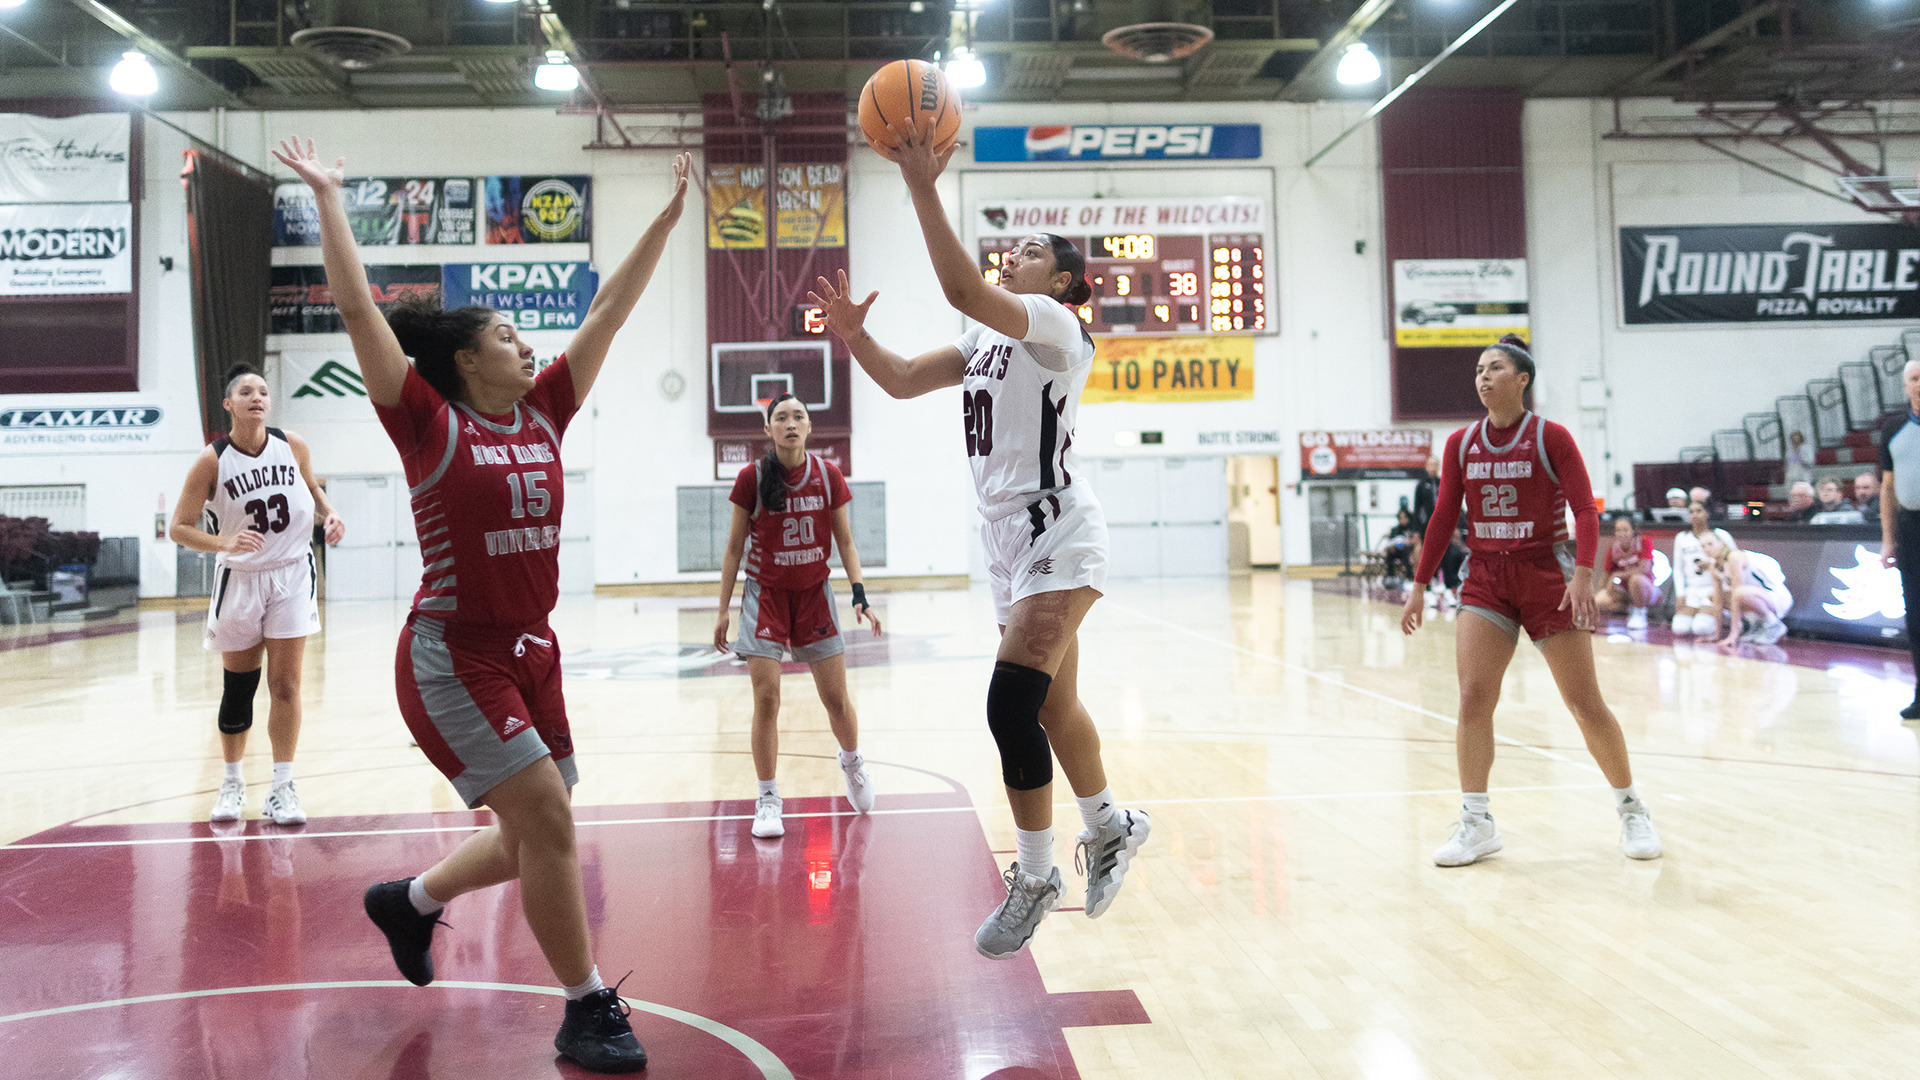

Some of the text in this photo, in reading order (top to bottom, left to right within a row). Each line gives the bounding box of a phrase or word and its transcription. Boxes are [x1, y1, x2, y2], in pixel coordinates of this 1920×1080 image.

[1068, 126, 1213, 156] PEPSI
[357, 180, 388, 206] 12
[405, 180, 435, 205] 24
[776, 190, 822, 210] ARDEN
[1013, 203, 1260, 227] HOME OF THE WILDCATS!
[0, 228, 123, 259] MODERN
[1103, 234, 1156, 260] 4:08
[1252, 247, 1263, 261] 7
[13, 267, 102, 277] Building Company
[470, 263, 577, 291] KPAY
[1252, 264, 1264, 279] 6
[1639, 231, 1919, 307] ROUND TABLE
[9, 279, 106, 287] General Contractors
[1116, 275, 1131, 296] 3
[1169, 272, 1198, 297] 38
[1252, 282, 1264, 295] 4
[470, 292, 577, 309] NEWS-TALK
[1253, 298, 1265, 313] 5
[1757, 296, 1899, 315] PIZZA ROYALTY
[543, 312, 576, 326] FM
[804, 307, 826, 334] 15
[1154, 304, 1170, 323] 4
[1253, 315, 1266, 330] 2
[1108, 357, 1240, 391] TO PARTY
[9, 410, 147, 427] LAMAR
[963, 388, 994, 458] 20
[3, 432, 151, 445] ADVERTISING COMPANY
[1236, 430, 1281, 443] STRONG
[1302, 430, 1431, 448] GO WILDCATS!
[470, 444, 512, 466] HOLY
[1466, 460, 1533, 480] HOLY NAMES
[223, 465, 296, 501] WILDCATS
[506, 471, 551, 519] 15
[1480, 484, 1519, 517] 22
[244, 492, 291, 535] 33
[782, 515, 815, 547] 20
[1473, 521, 1535, 539] UNIVERSITY
